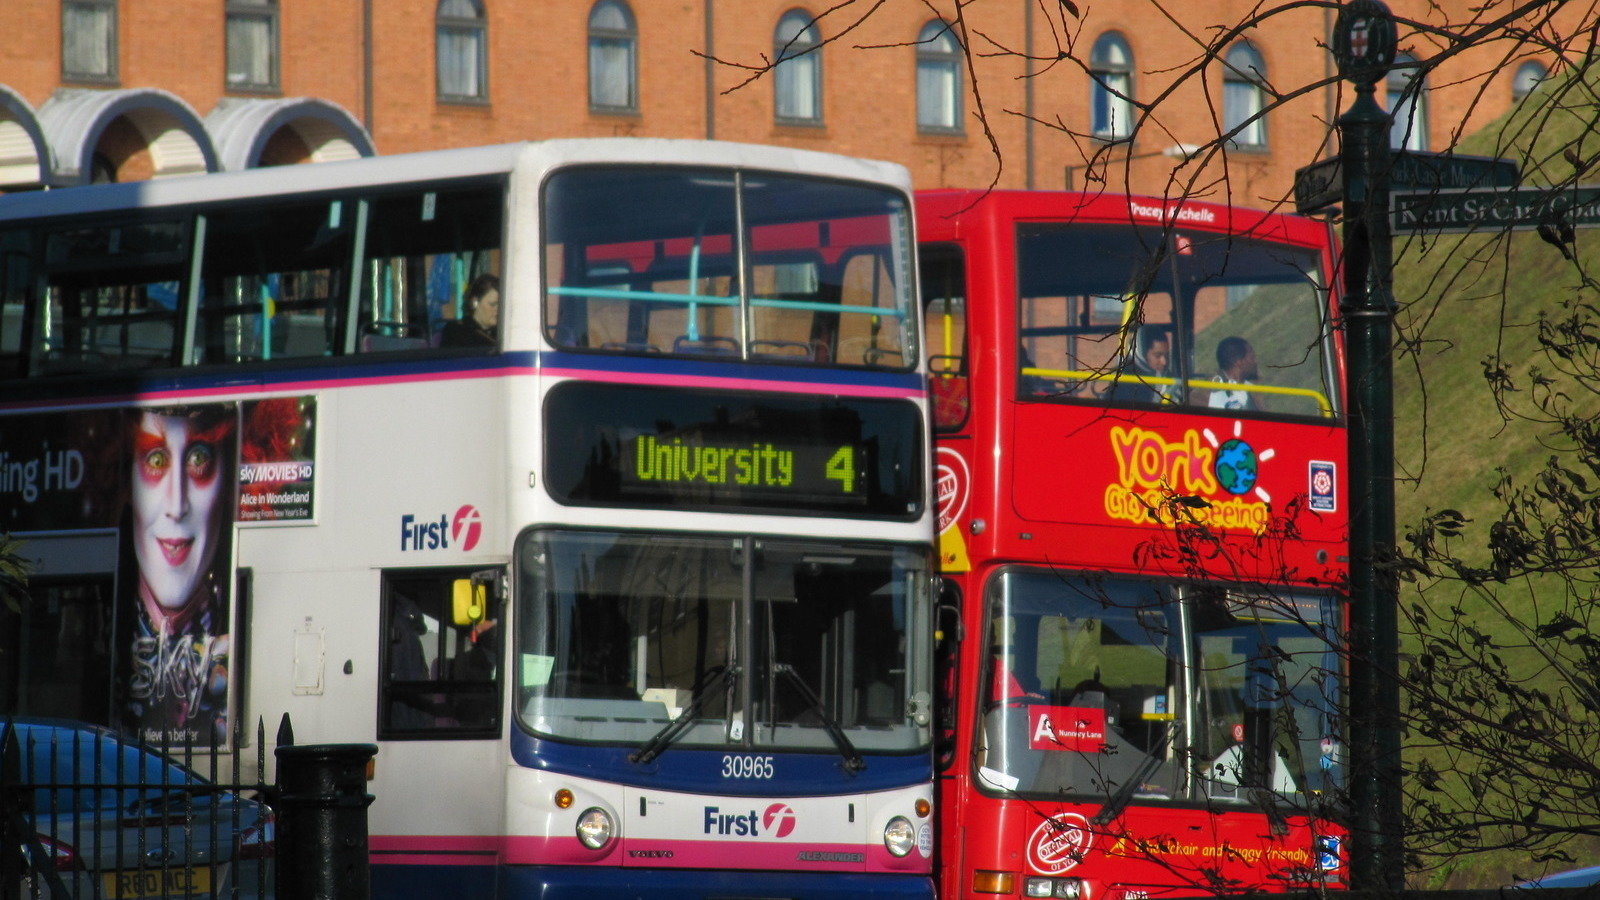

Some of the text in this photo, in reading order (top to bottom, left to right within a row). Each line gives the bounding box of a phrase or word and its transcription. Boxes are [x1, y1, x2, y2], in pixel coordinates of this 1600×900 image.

[1130, 202, 1164, 222] Tracey
[1401, 201, 1458, 224] Kent
[1463, 198, 1487, 222] St
[44, 449, 84, 491] HD
[638, 435, 855, 493] University 4
[1111, 427, 1217, 494] York
[241, 465, 313, 483] sky MOVIES HD
[241, 493, 257, 505] Alice
[266, 491, 310, 504] Wonderland
[401, 514, 448, 551] First
[1033, 714, 1057, 742] A
[1086, 731, 1102, 739] Lane
[722, 755, 775, 778] 30965
[704, 806, 759, 837] First
[797, 851, 866, 863] ALEXANDER
[1201, 843, 1224, 857] and
